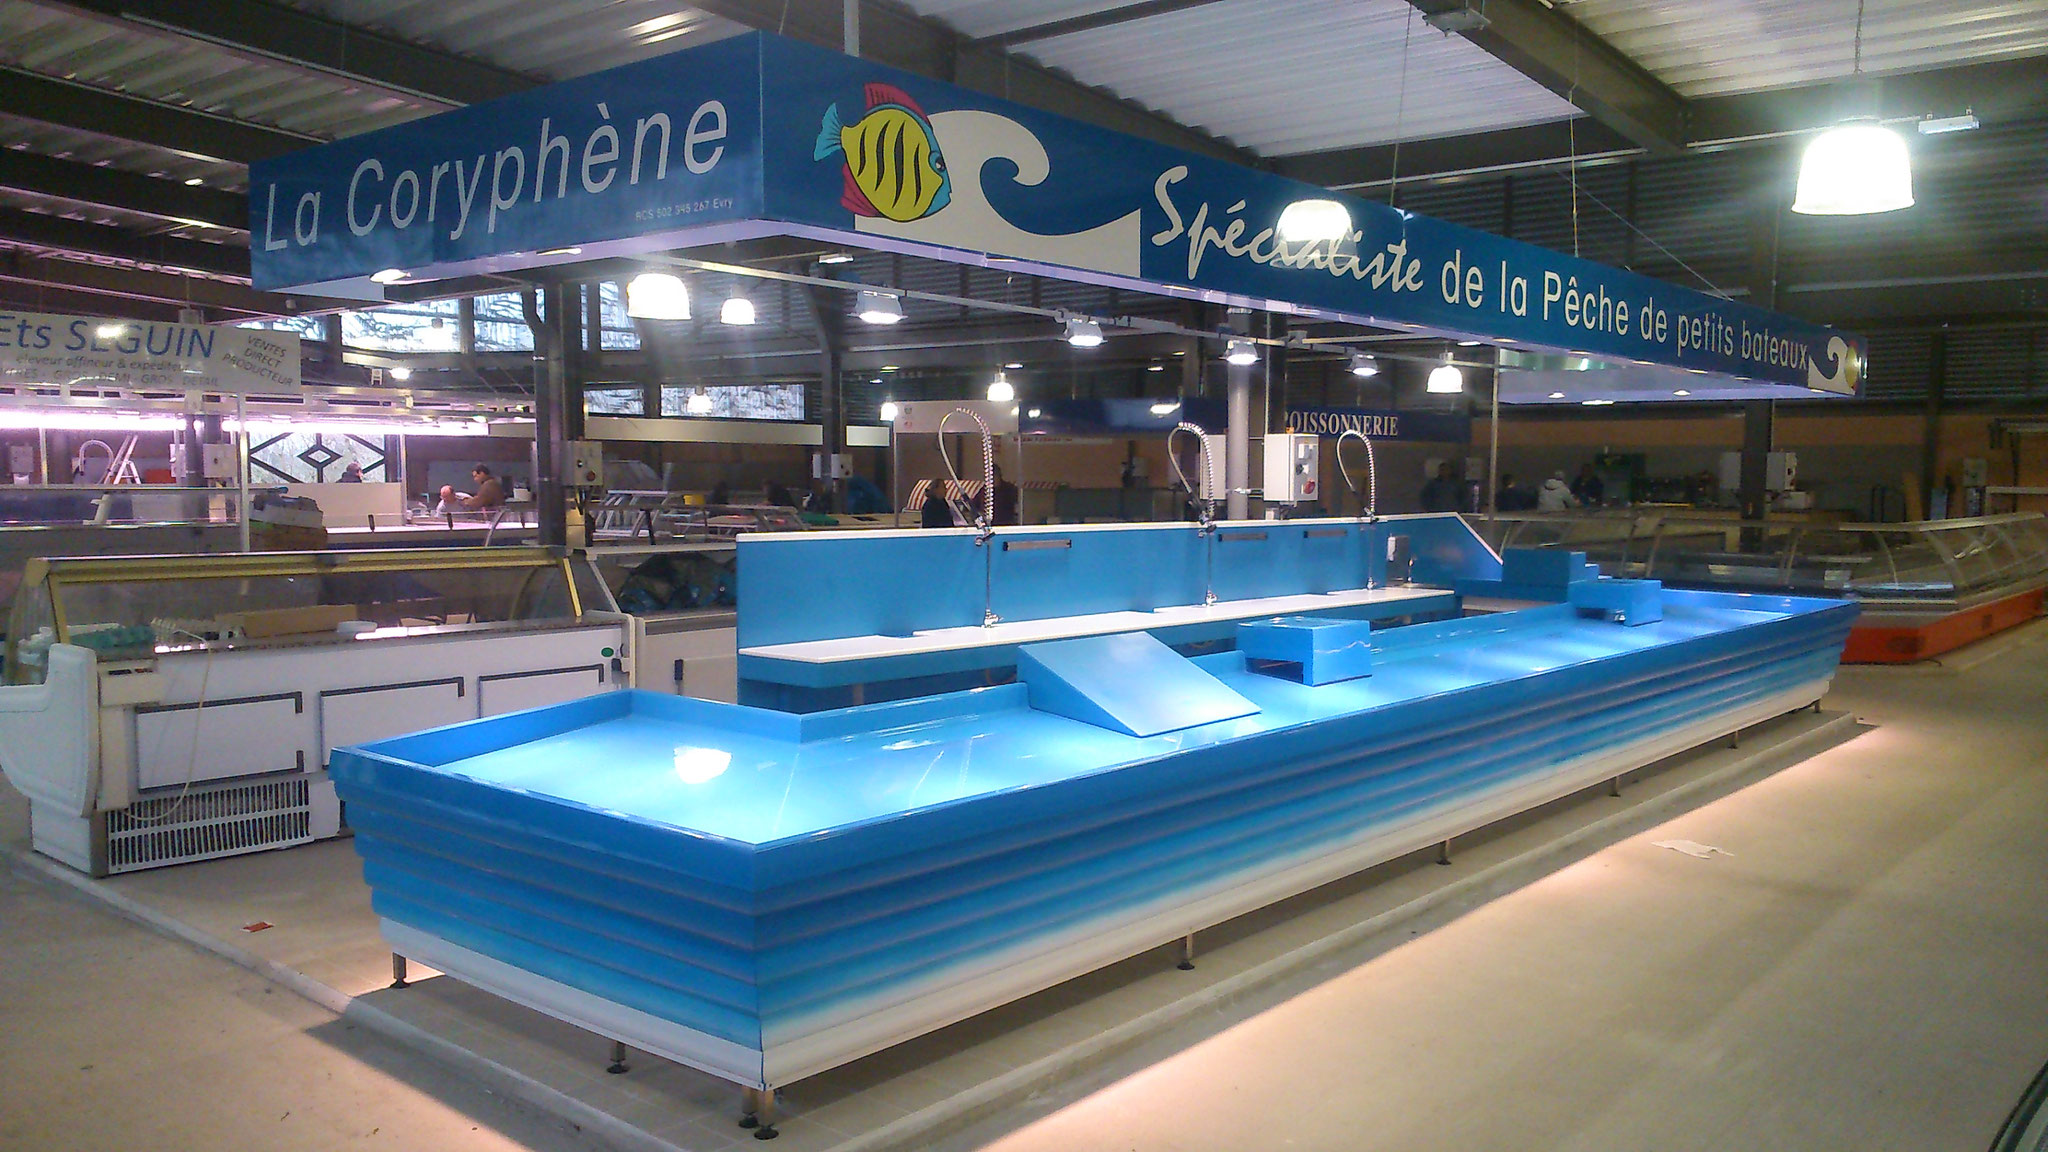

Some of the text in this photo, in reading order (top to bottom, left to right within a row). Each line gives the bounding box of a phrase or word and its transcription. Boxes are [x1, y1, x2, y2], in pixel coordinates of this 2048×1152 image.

[264, 100, 727, 251] La Coryphène
[713, 198, 733, 209] Evry
[1152, 165, 1807, 370] Spécialiste de la Pêche de petits bateaux
[244, 348, 282, 368] DIRECT
[247, 335, 287, 358] VENTES
[222, 352, 294, 387] PRODUCTEUR
